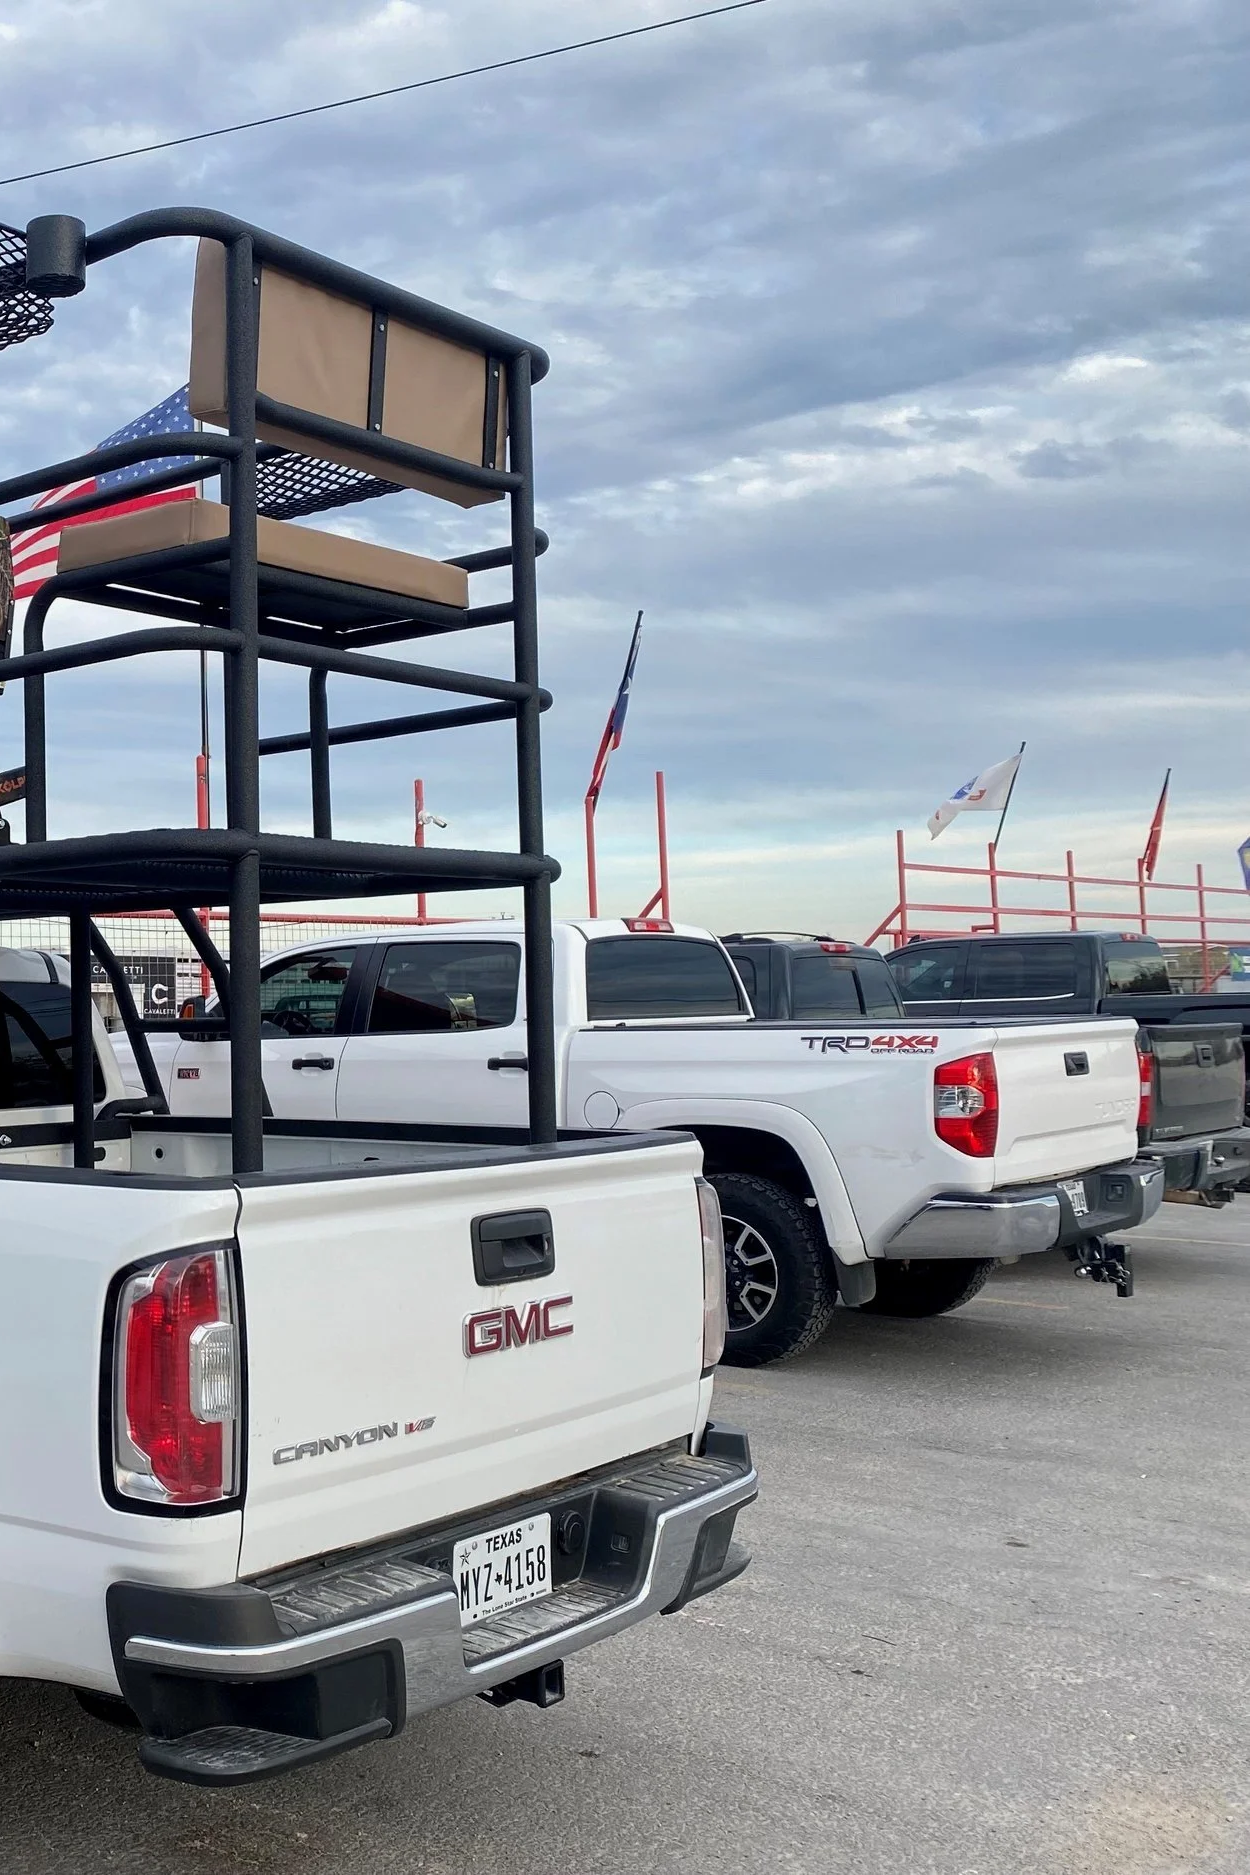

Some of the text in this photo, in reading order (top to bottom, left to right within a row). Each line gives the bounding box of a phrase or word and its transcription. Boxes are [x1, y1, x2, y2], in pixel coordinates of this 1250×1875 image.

[92, 965, 144, 975] CAETTI
[463, 1292, 574, 1359] GMC
[272, 1416, 437, 1466] CANYON V6
[486, 1527, 522, 1554] TEXAS
[514, 1595, 527, 1603] State
